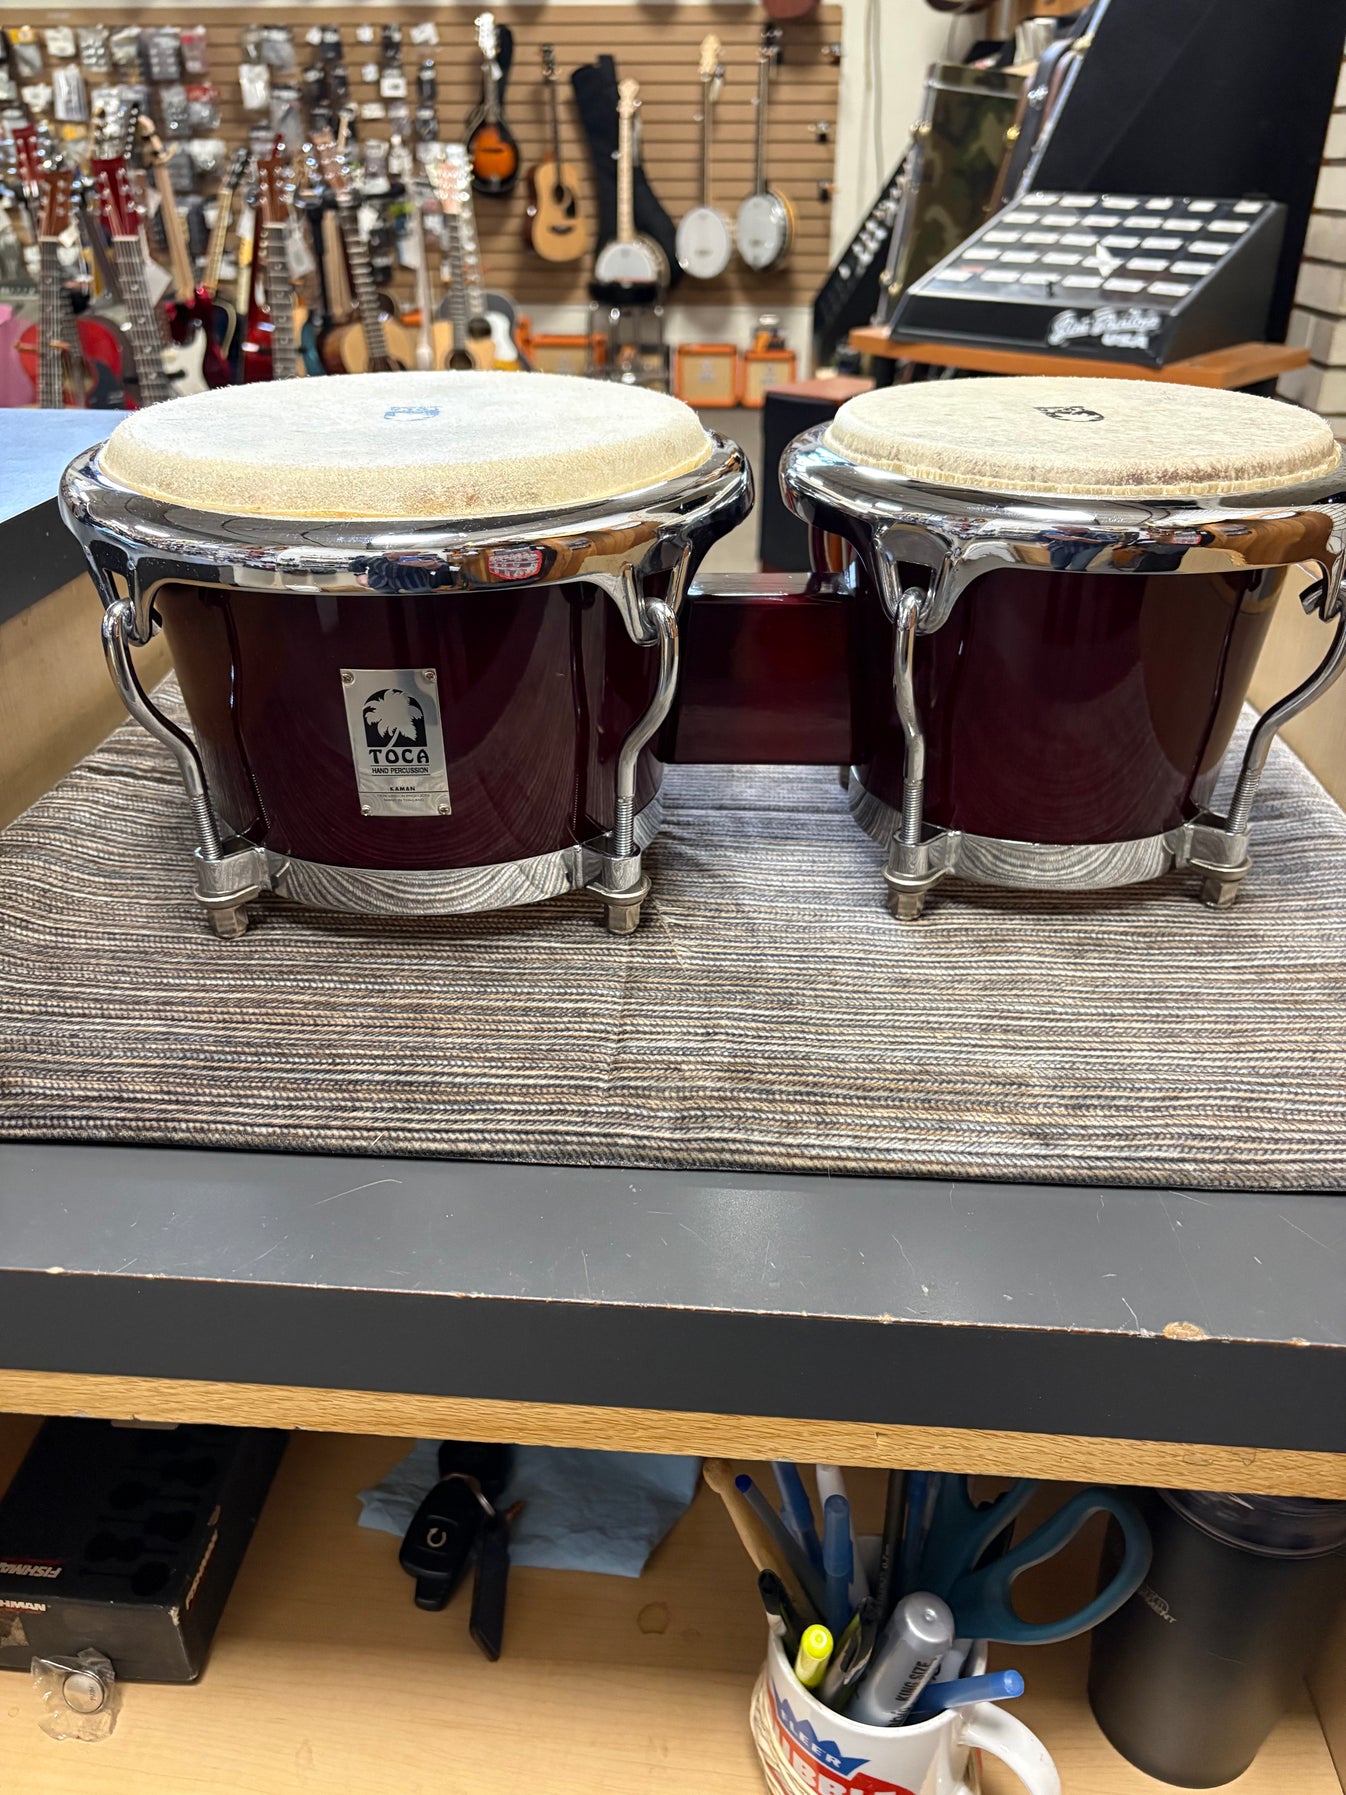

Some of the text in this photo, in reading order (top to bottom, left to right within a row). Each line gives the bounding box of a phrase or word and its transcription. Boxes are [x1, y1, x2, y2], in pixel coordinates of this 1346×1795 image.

[369, 748, 430, 764] TOCA
[895, 1681, 920, 1702] KING
[908, 1660, 931, 1681] SIZE
